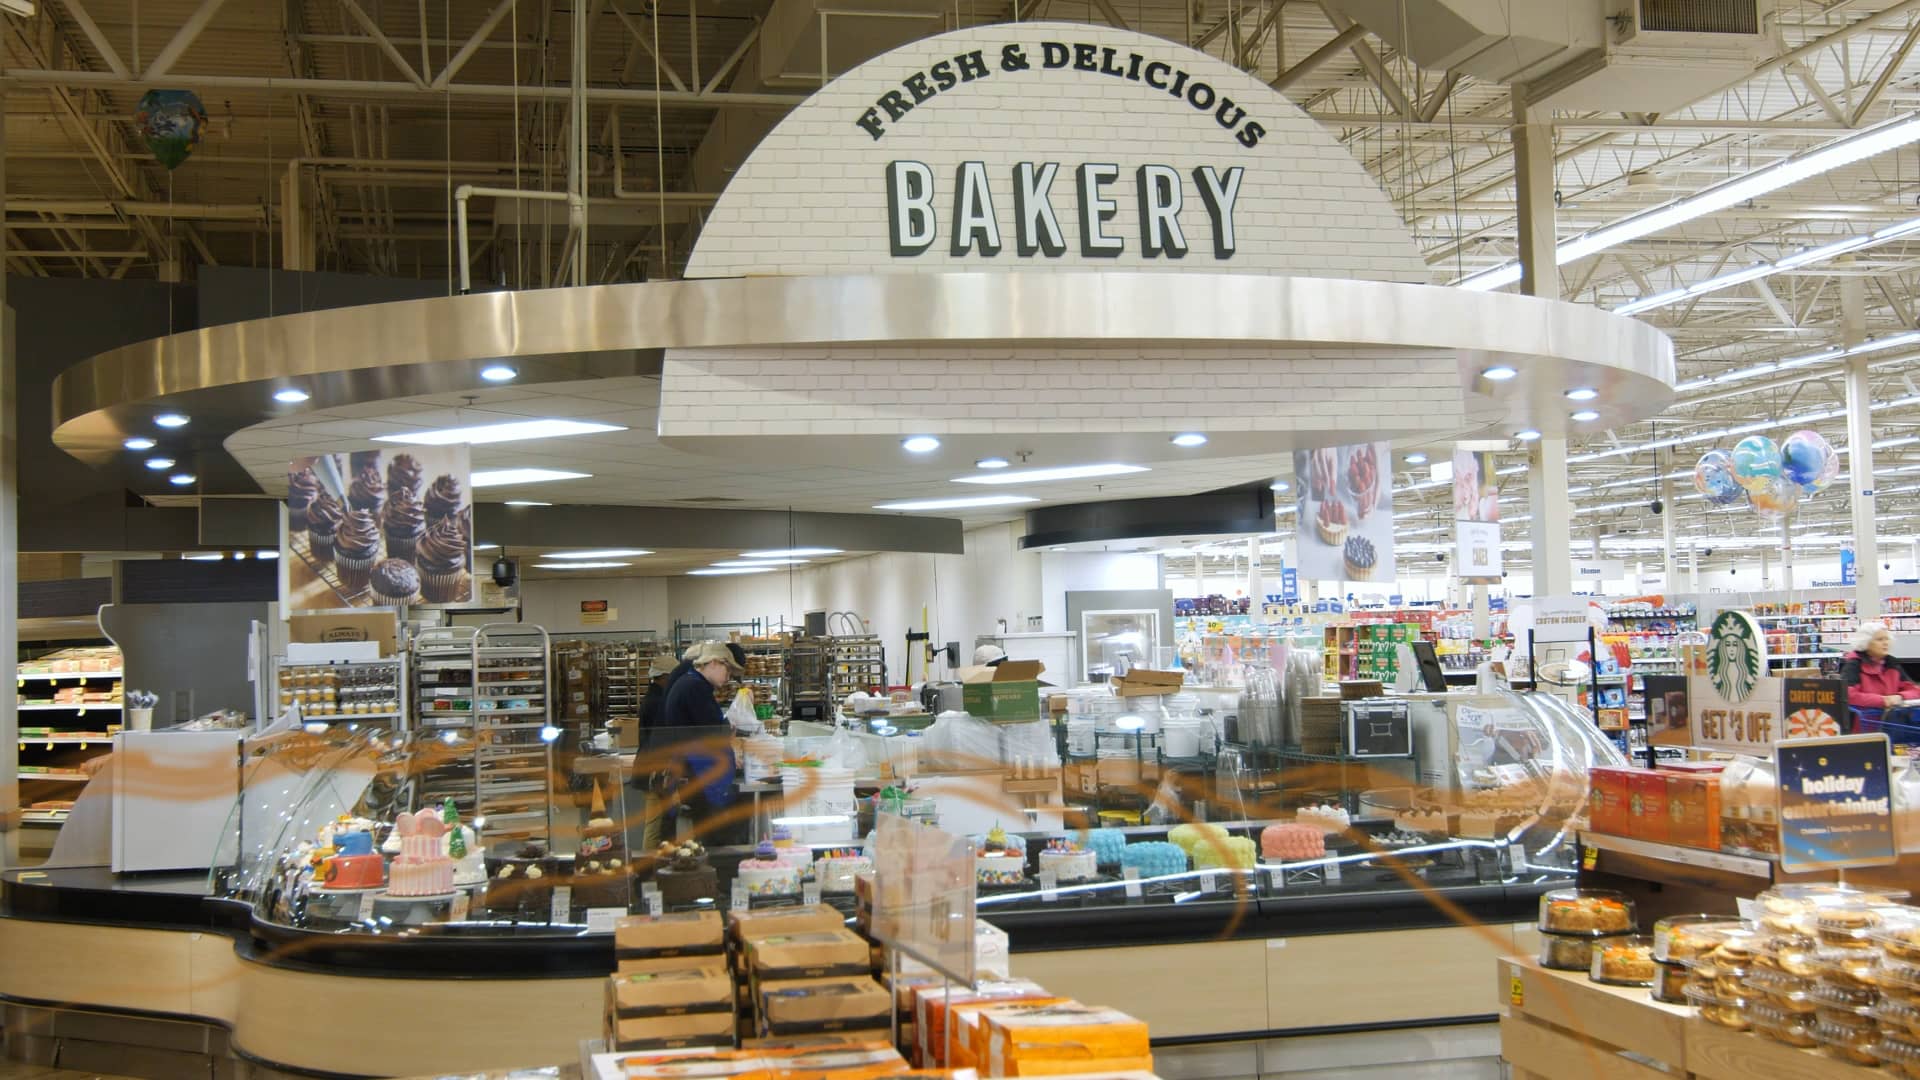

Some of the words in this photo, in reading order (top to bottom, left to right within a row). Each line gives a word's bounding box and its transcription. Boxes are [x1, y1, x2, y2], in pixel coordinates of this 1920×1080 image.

[856, 51, 989, 140] FRESH
[1001, 44, 1029, 71] &
[1041, 42, 1265, 148] DELICIOUS
[886, 161, 1244, 259] BAKERY
[1817, 690, 1836, 705] CAKE
[1701, 709, 1727, 740] GET
[1729, 709, 1745, 742] $3
[1747, 711, 1772, 743] OFF
[1801, 774, 1865, 795] holiday
